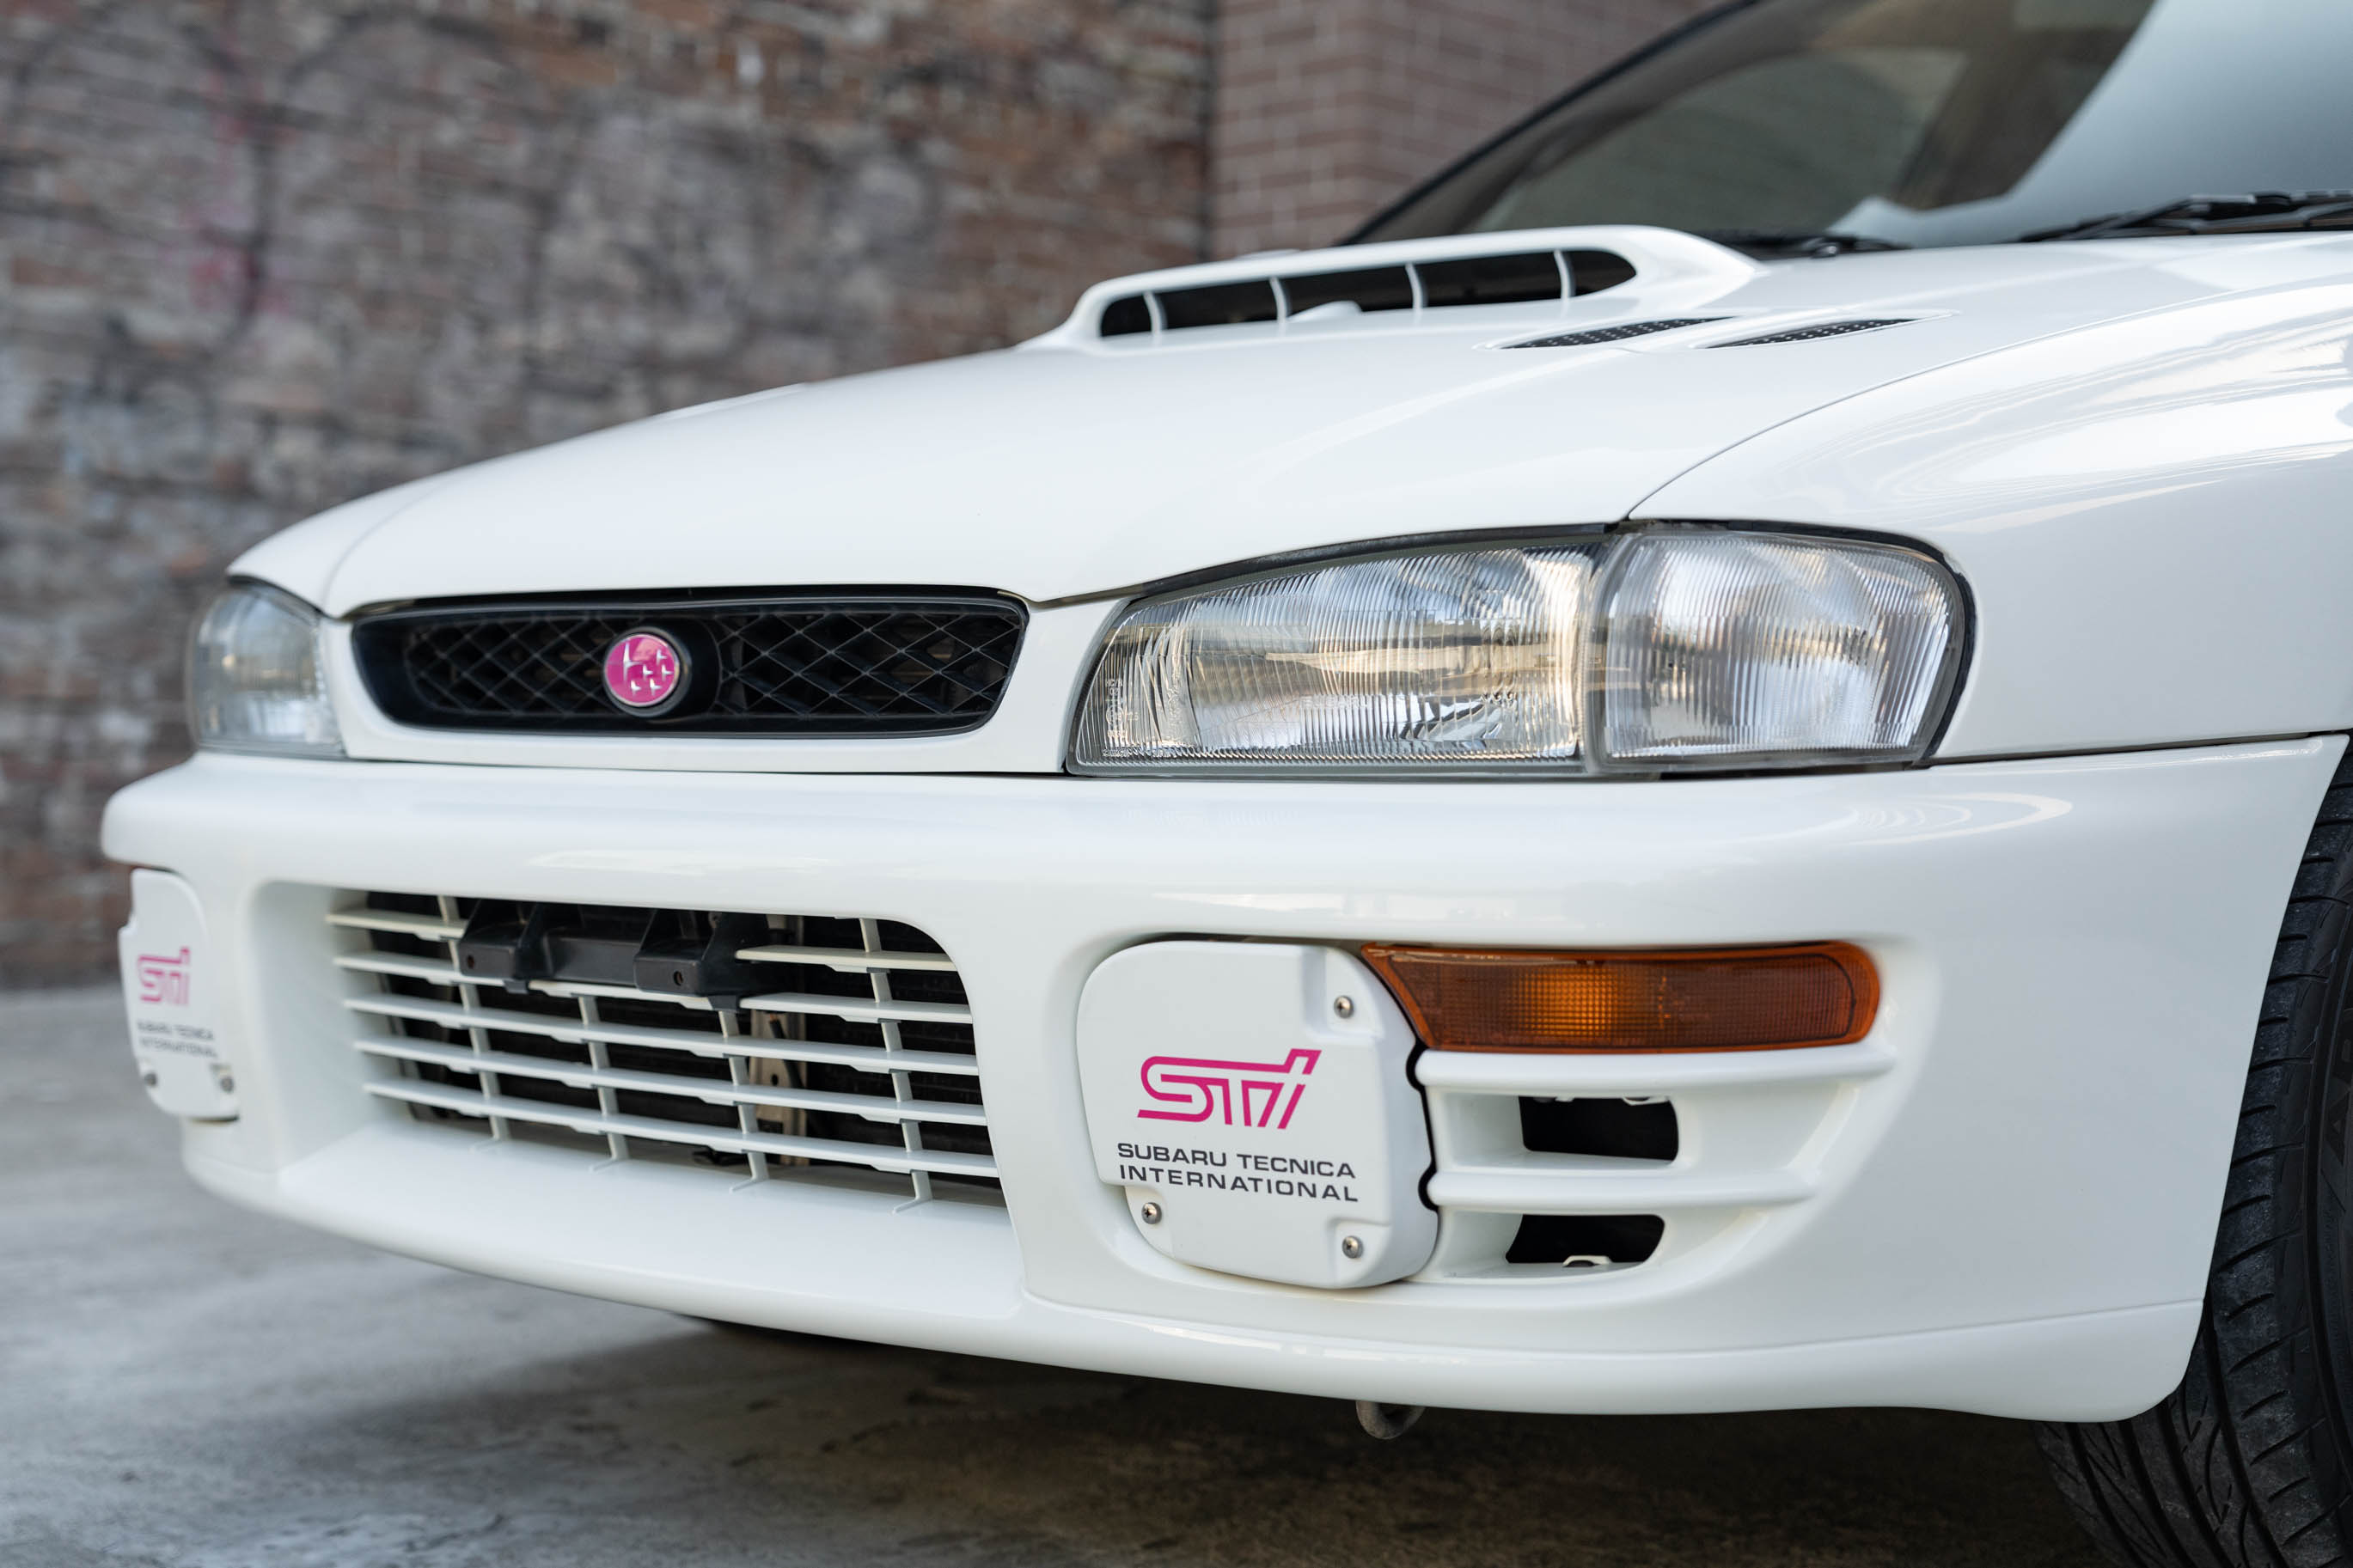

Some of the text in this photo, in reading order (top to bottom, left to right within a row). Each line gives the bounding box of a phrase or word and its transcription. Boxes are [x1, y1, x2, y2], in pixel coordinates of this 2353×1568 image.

[1117, 1142, 1356, 1179] SUBARU TECNICA
[1119, 1164, 1359, 1203] INTERNATIONAL
